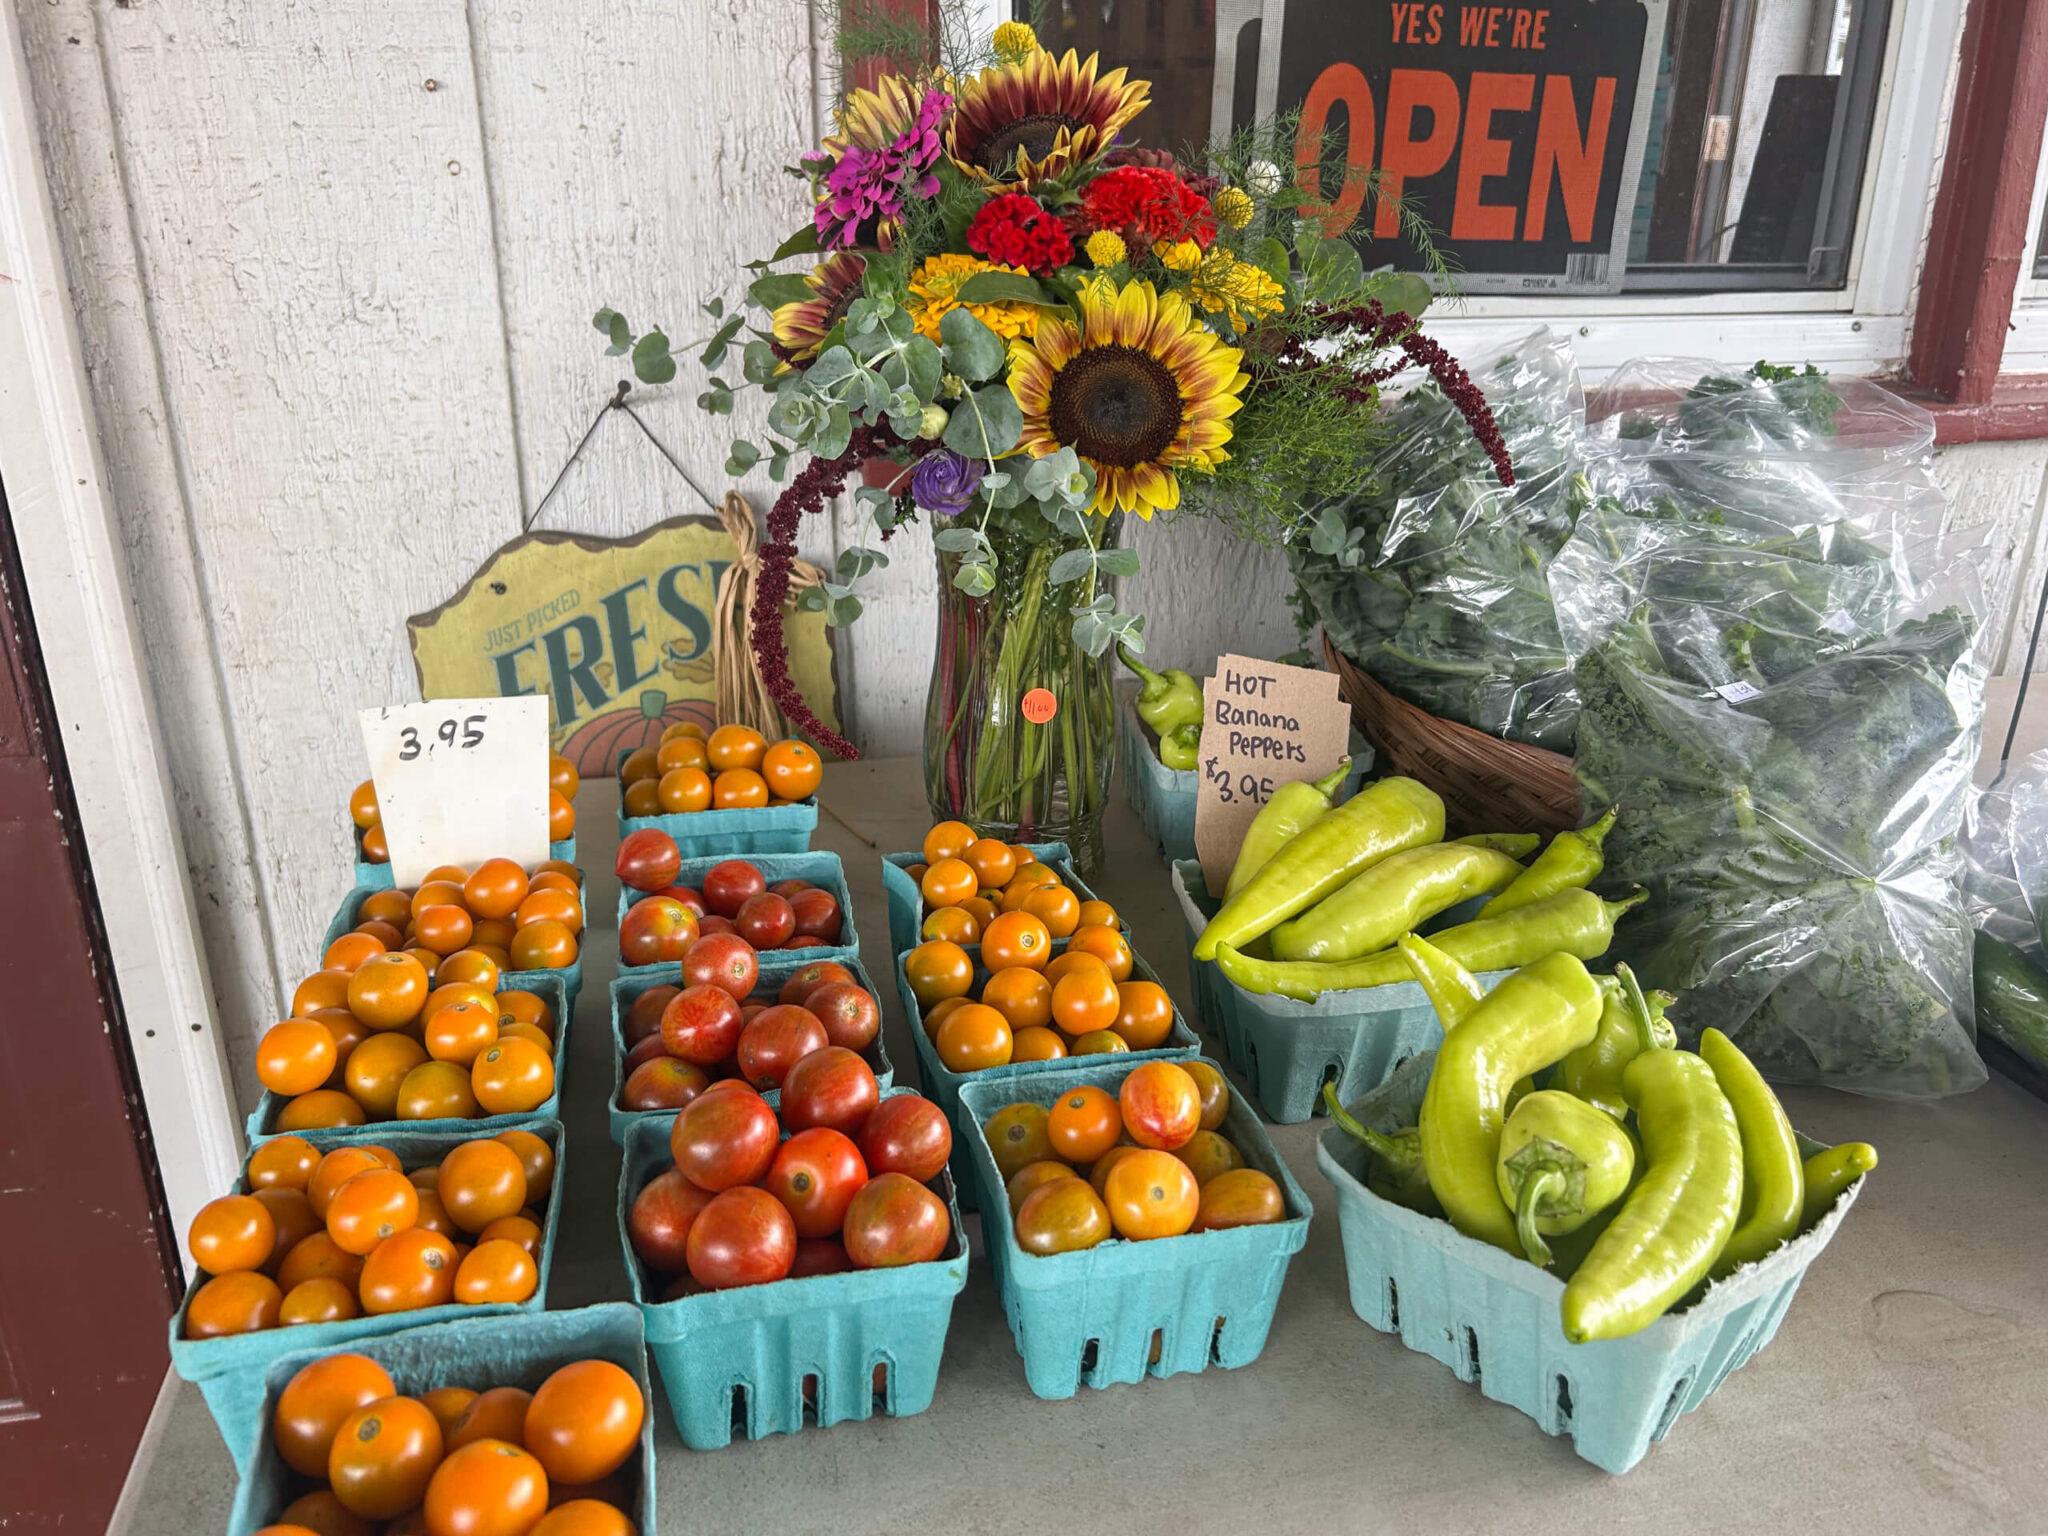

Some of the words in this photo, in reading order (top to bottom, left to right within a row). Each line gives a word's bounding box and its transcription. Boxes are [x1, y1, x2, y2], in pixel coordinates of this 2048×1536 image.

[1391, 2, 1444, 44] YES
[1460, 6, 1550, 50] WE'RE
[1296, 62, 1618, 243] OPEN
[483, 620, 521, 652] JUST
[526, 588, 581, 633] PICKED
[1225, 669, 1277, 699] HOT
[1215, 700, 1300, 732] Banana
